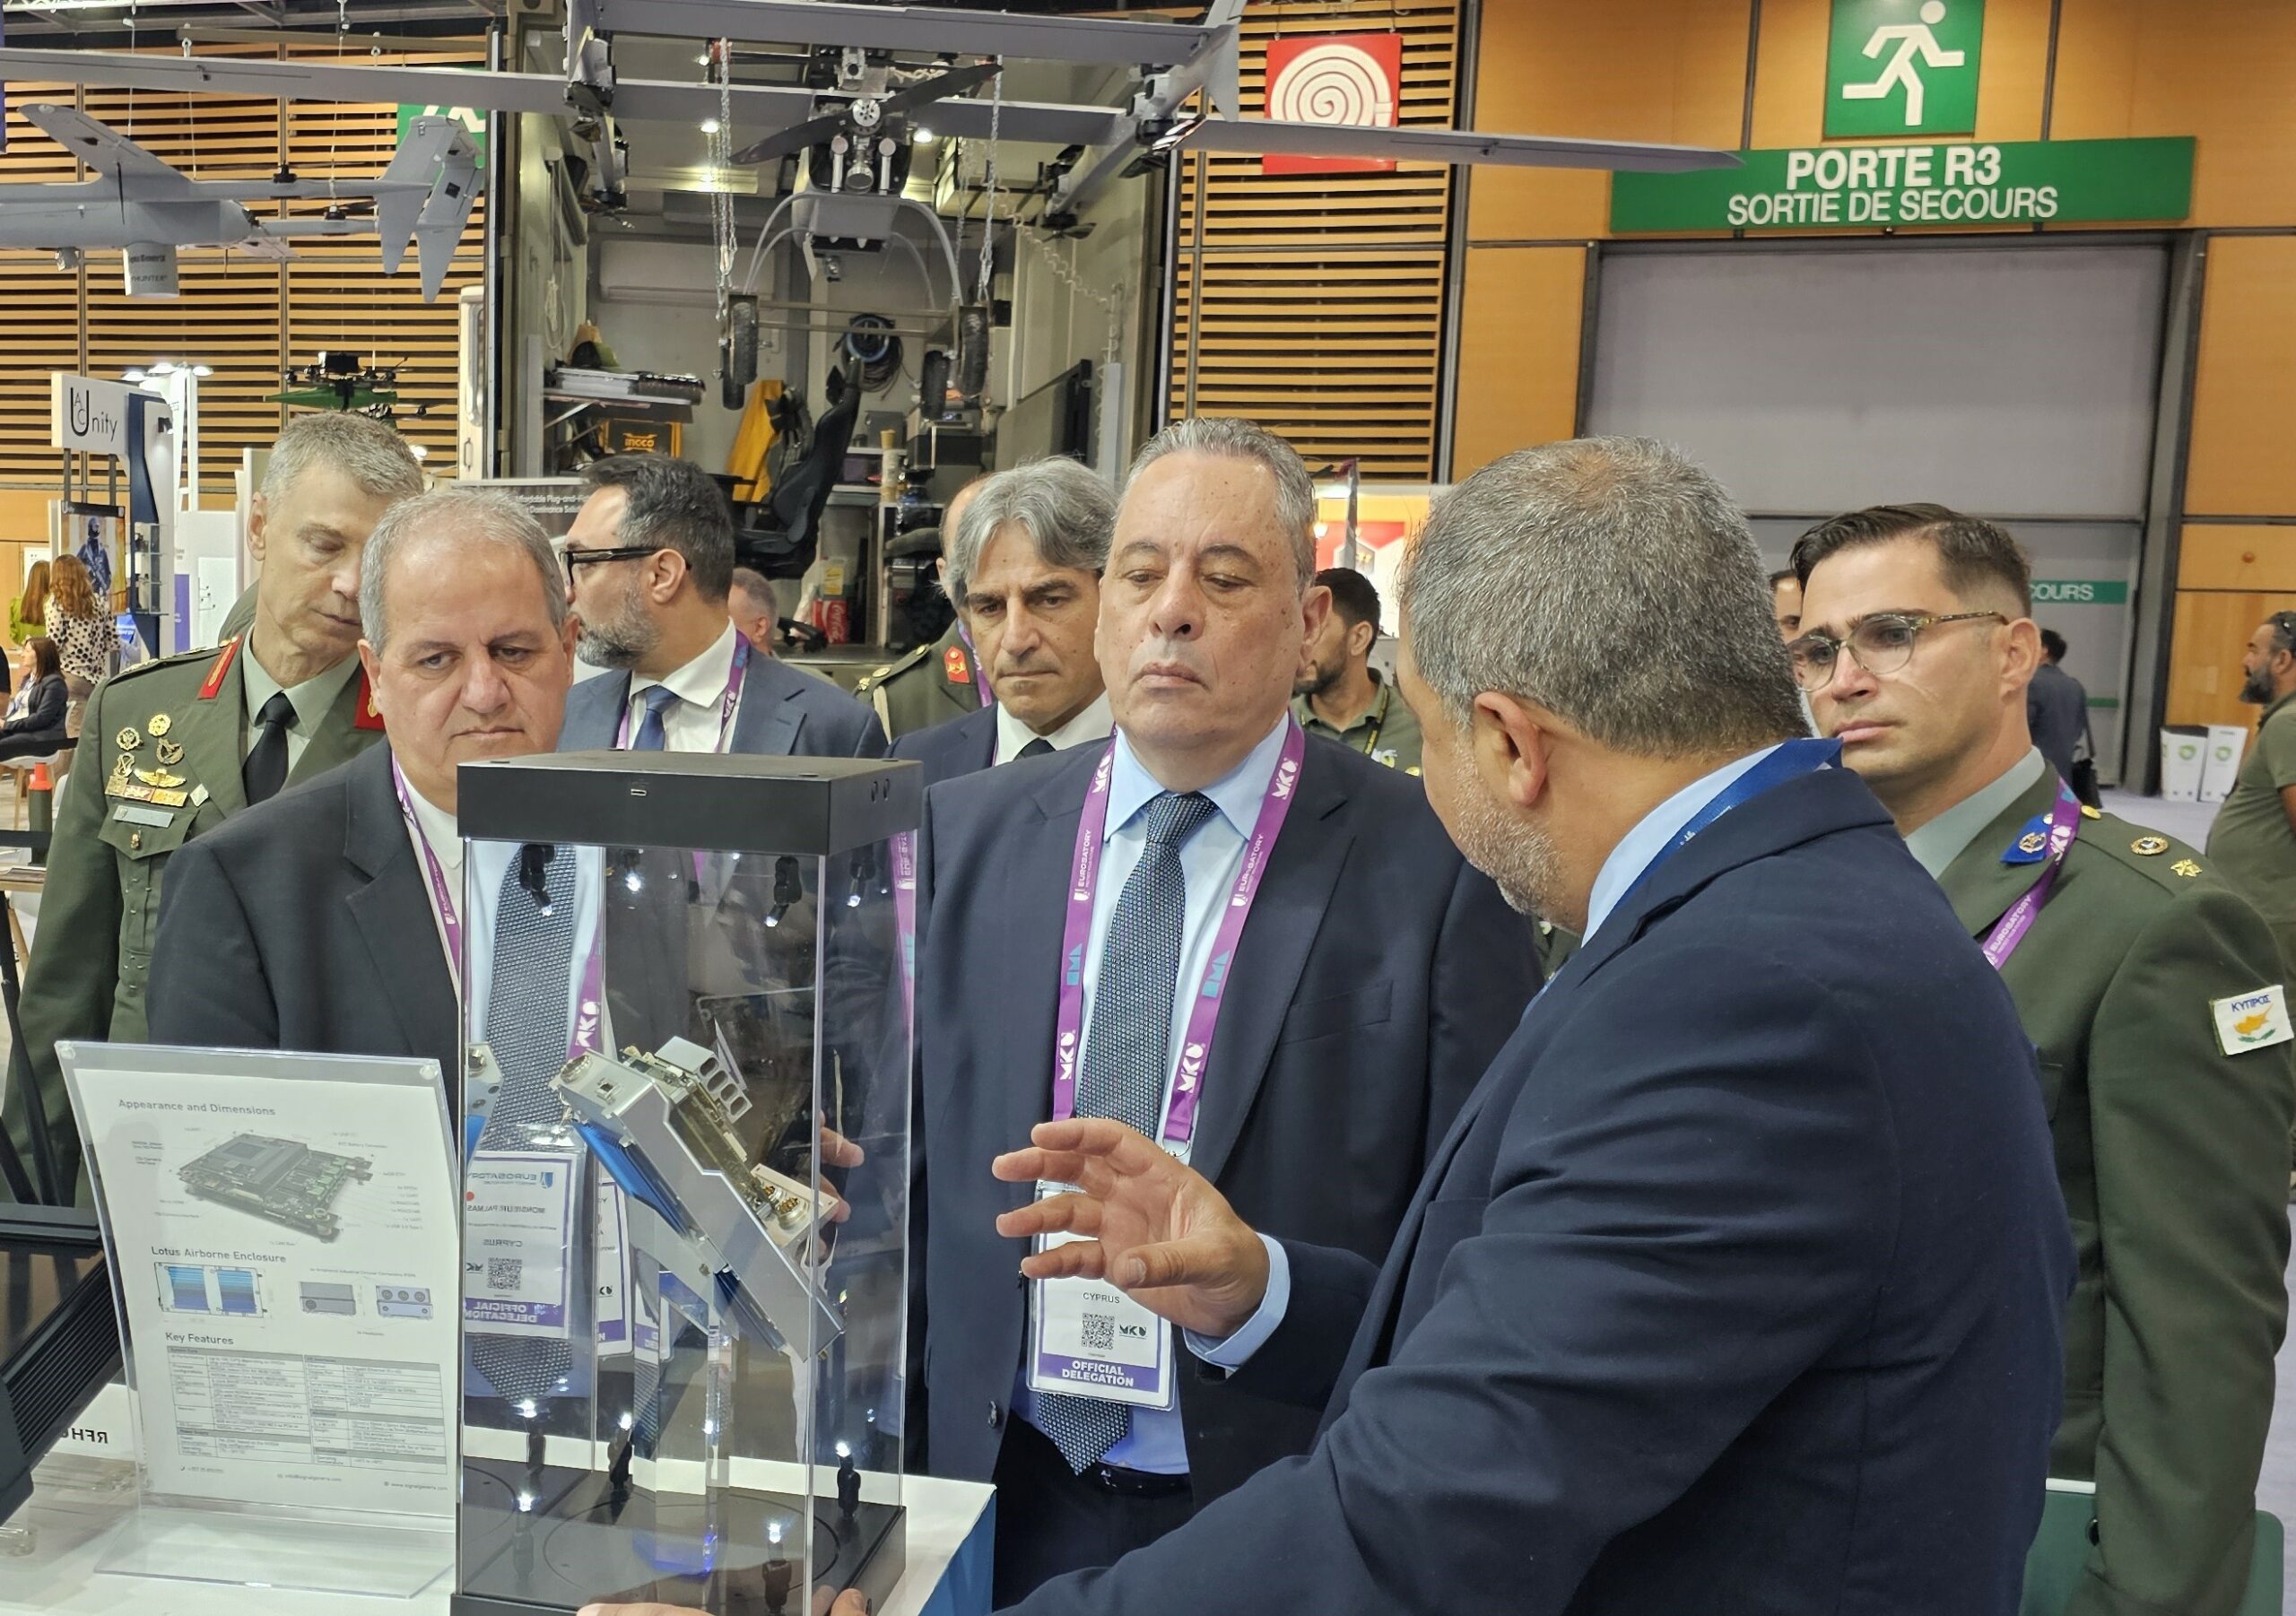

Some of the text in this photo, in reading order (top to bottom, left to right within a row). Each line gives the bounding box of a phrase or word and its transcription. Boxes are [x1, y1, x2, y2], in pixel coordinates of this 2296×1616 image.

[1787, 145, 2001, 190] PORTE R3
[1727, 187, 2058, 225] SORTIE DE SECOURS
[118, 1099, 276, 1116] Appearance and Dimensions
[151, 1247, 286, 1263] Lotus Airborne Enclosure
[1083, 1292, 1120, 1304] CYPRUS
[165, 1332, 234, 1345] Key Features
[1072, 1360, 1125, 1376] OFFICIAL
[1062, 1368, 1135, 1387] DELEGATION
